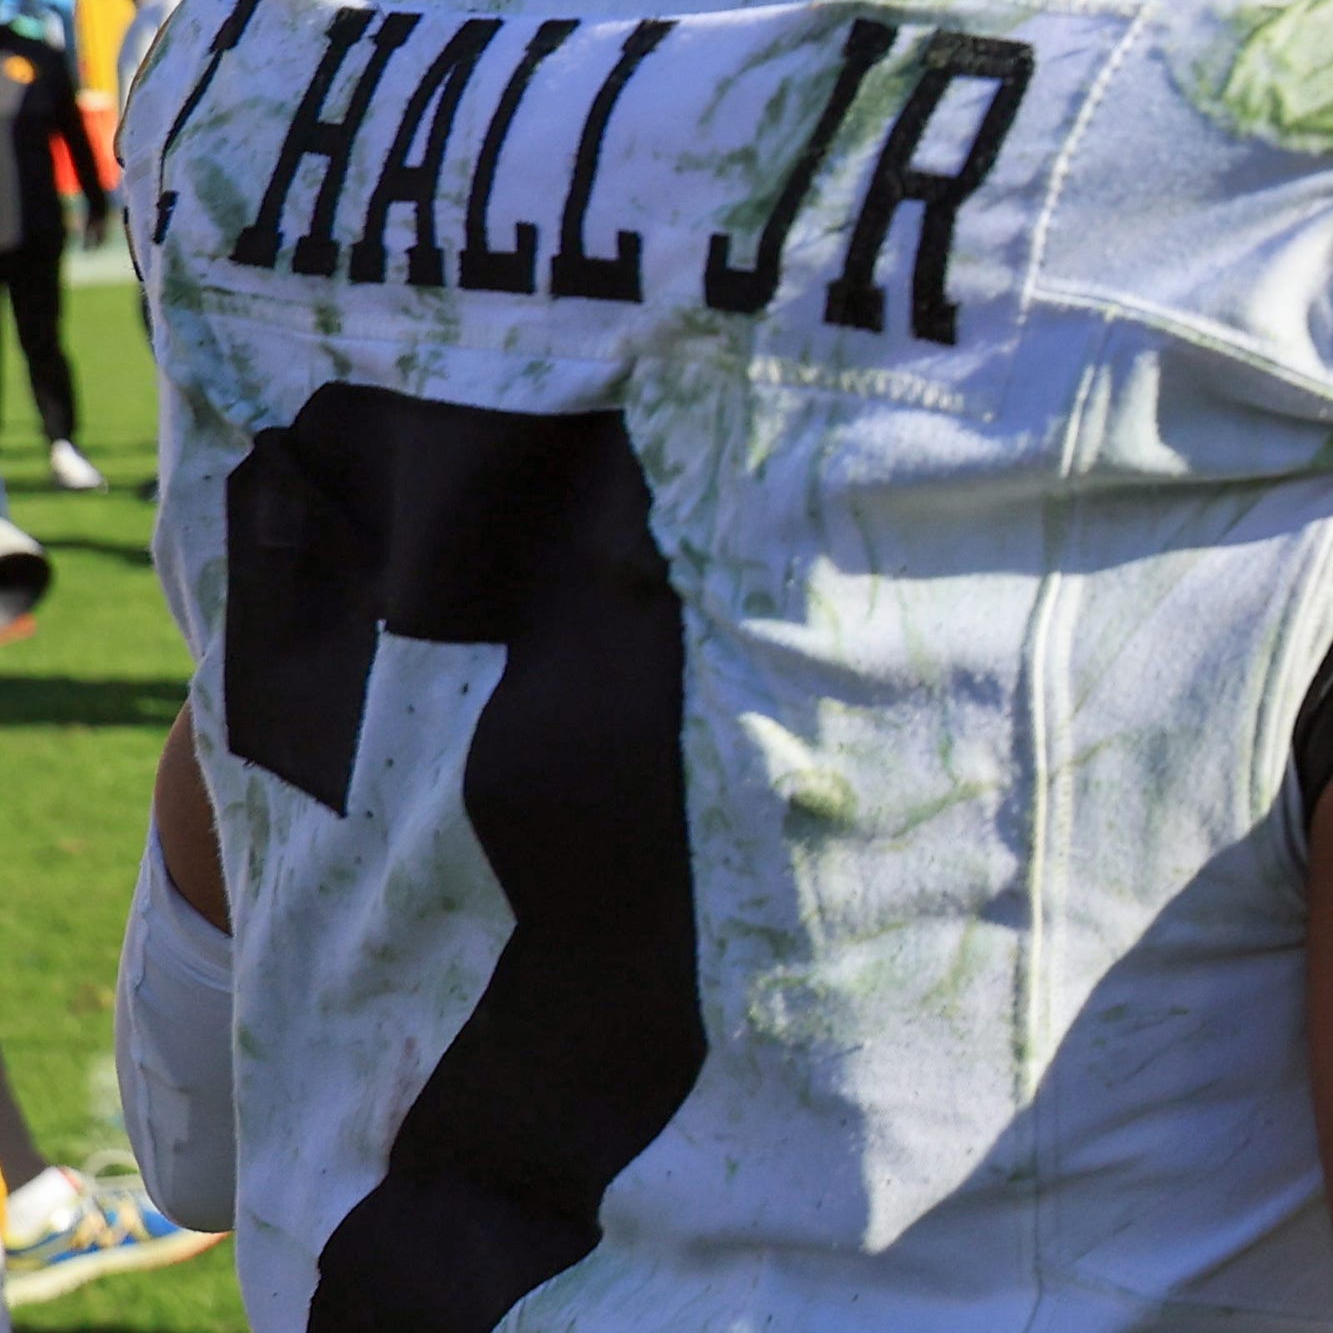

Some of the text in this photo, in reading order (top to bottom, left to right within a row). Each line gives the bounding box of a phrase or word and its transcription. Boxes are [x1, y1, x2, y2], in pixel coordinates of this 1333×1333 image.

[229, 5, 679, 305] HALL
[704, 17, 1036, 347] JR
[223, 380, 709, 1333] 7
